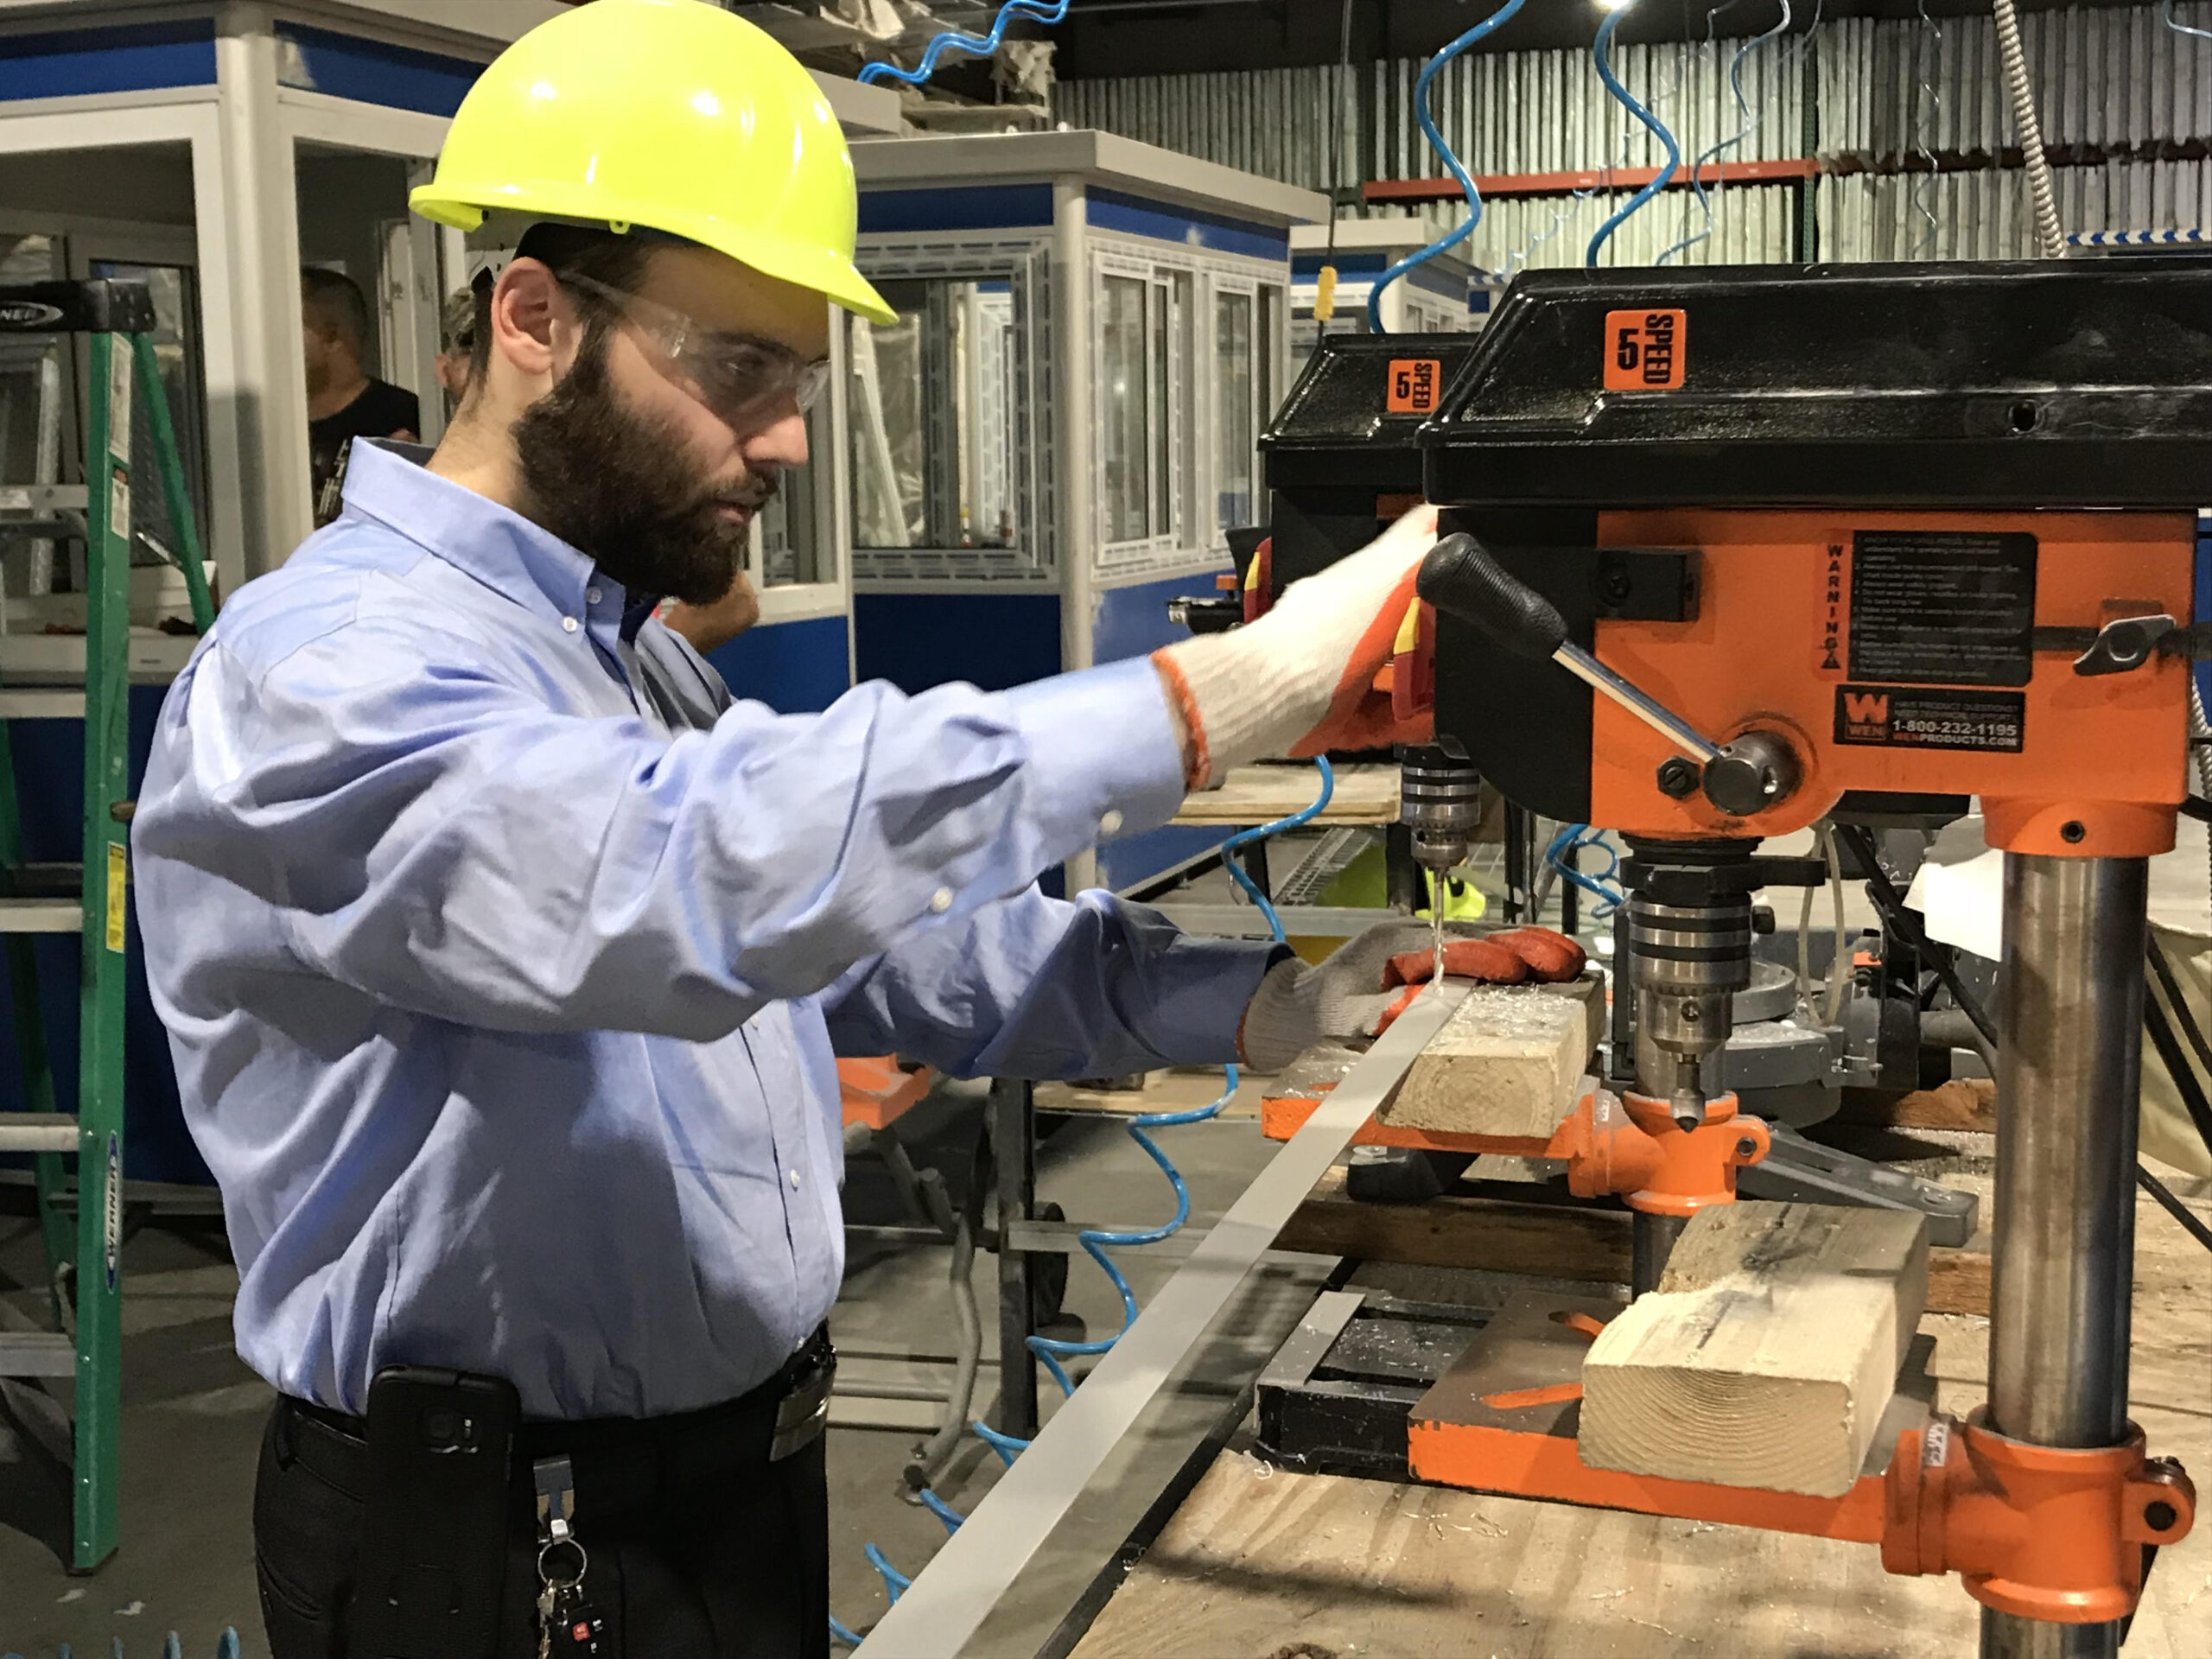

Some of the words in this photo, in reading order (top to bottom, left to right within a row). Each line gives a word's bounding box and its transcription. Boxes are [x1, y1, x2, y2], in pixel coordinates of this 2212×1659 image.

[1617, 327, 1640, 371] 5
[1643, 313, 1675, 385] SPEED
[1395, 371, 1410, 400] 5
[1412, 362, 1433, 409] SPEED
[1892, 719, 2018, 737] 1-800-232-1195
